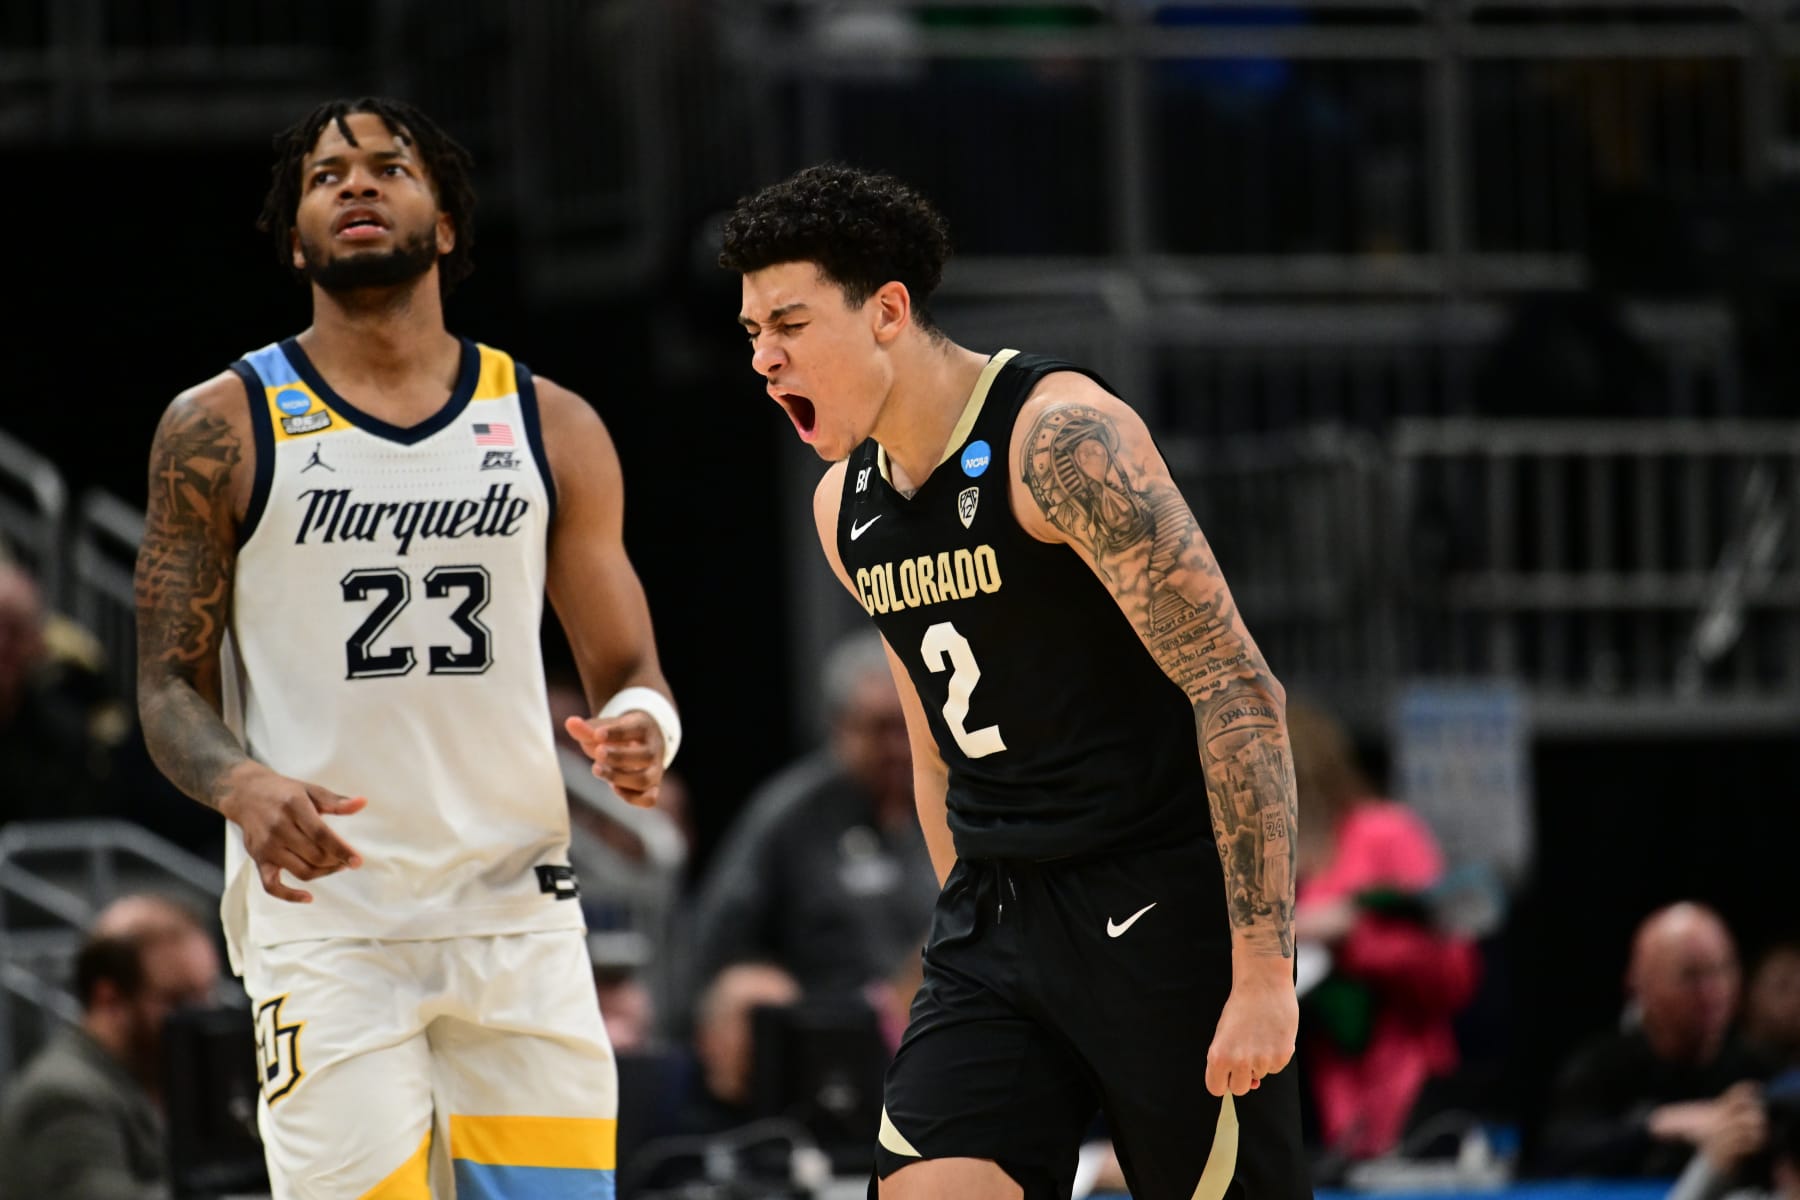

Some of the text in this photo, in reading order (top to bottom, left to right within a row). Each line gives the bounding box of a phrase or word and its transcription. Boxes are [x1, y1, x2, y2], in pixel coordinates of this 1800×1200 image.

[965, 456, 989, 469] NCAA
[960, 489, 978, 508] PAC
[295, 483, 529, 555] Marquette
[962, 504, 973, 519] 12
[856, 544, 1002, 617] COLORADO
[340, 565, 494, 680] 23
[1194, 640, 1216, 656] Lord
[1206, 658, 1221, 672] his
[920, 621, 1007, 758] 2
[1265, 818, 1285, 841] 24
